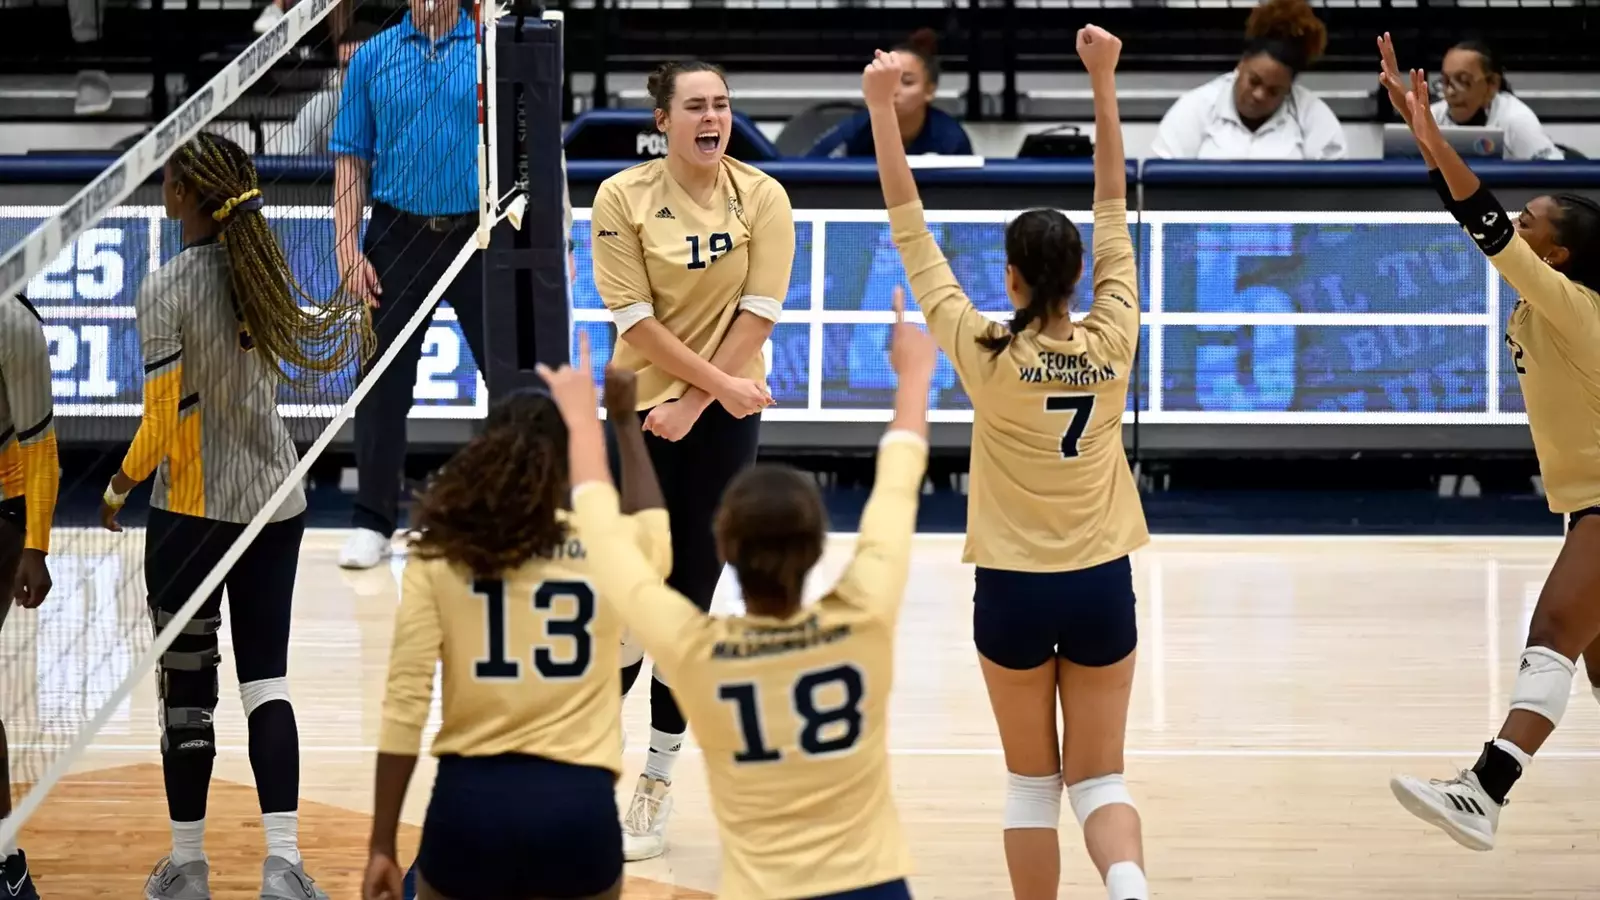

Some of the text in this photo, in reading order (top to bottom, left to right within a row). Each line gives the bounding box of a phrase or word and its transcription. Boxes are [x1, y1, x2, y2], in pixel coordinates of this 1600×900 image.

[27, 228, 124, 299] 25
[686, 231, 733, 270] 19
[41, 325, 117, 396] 21
[413, 327, 459, 399] 2
[1038, 352, 1093, 370] GEORG
[1505, 333, 1526, 375] 2
[1045, 395, 1096, 458] 7
[471, 580, 595, 679] 13
[718, 664, 865, 763] 18
